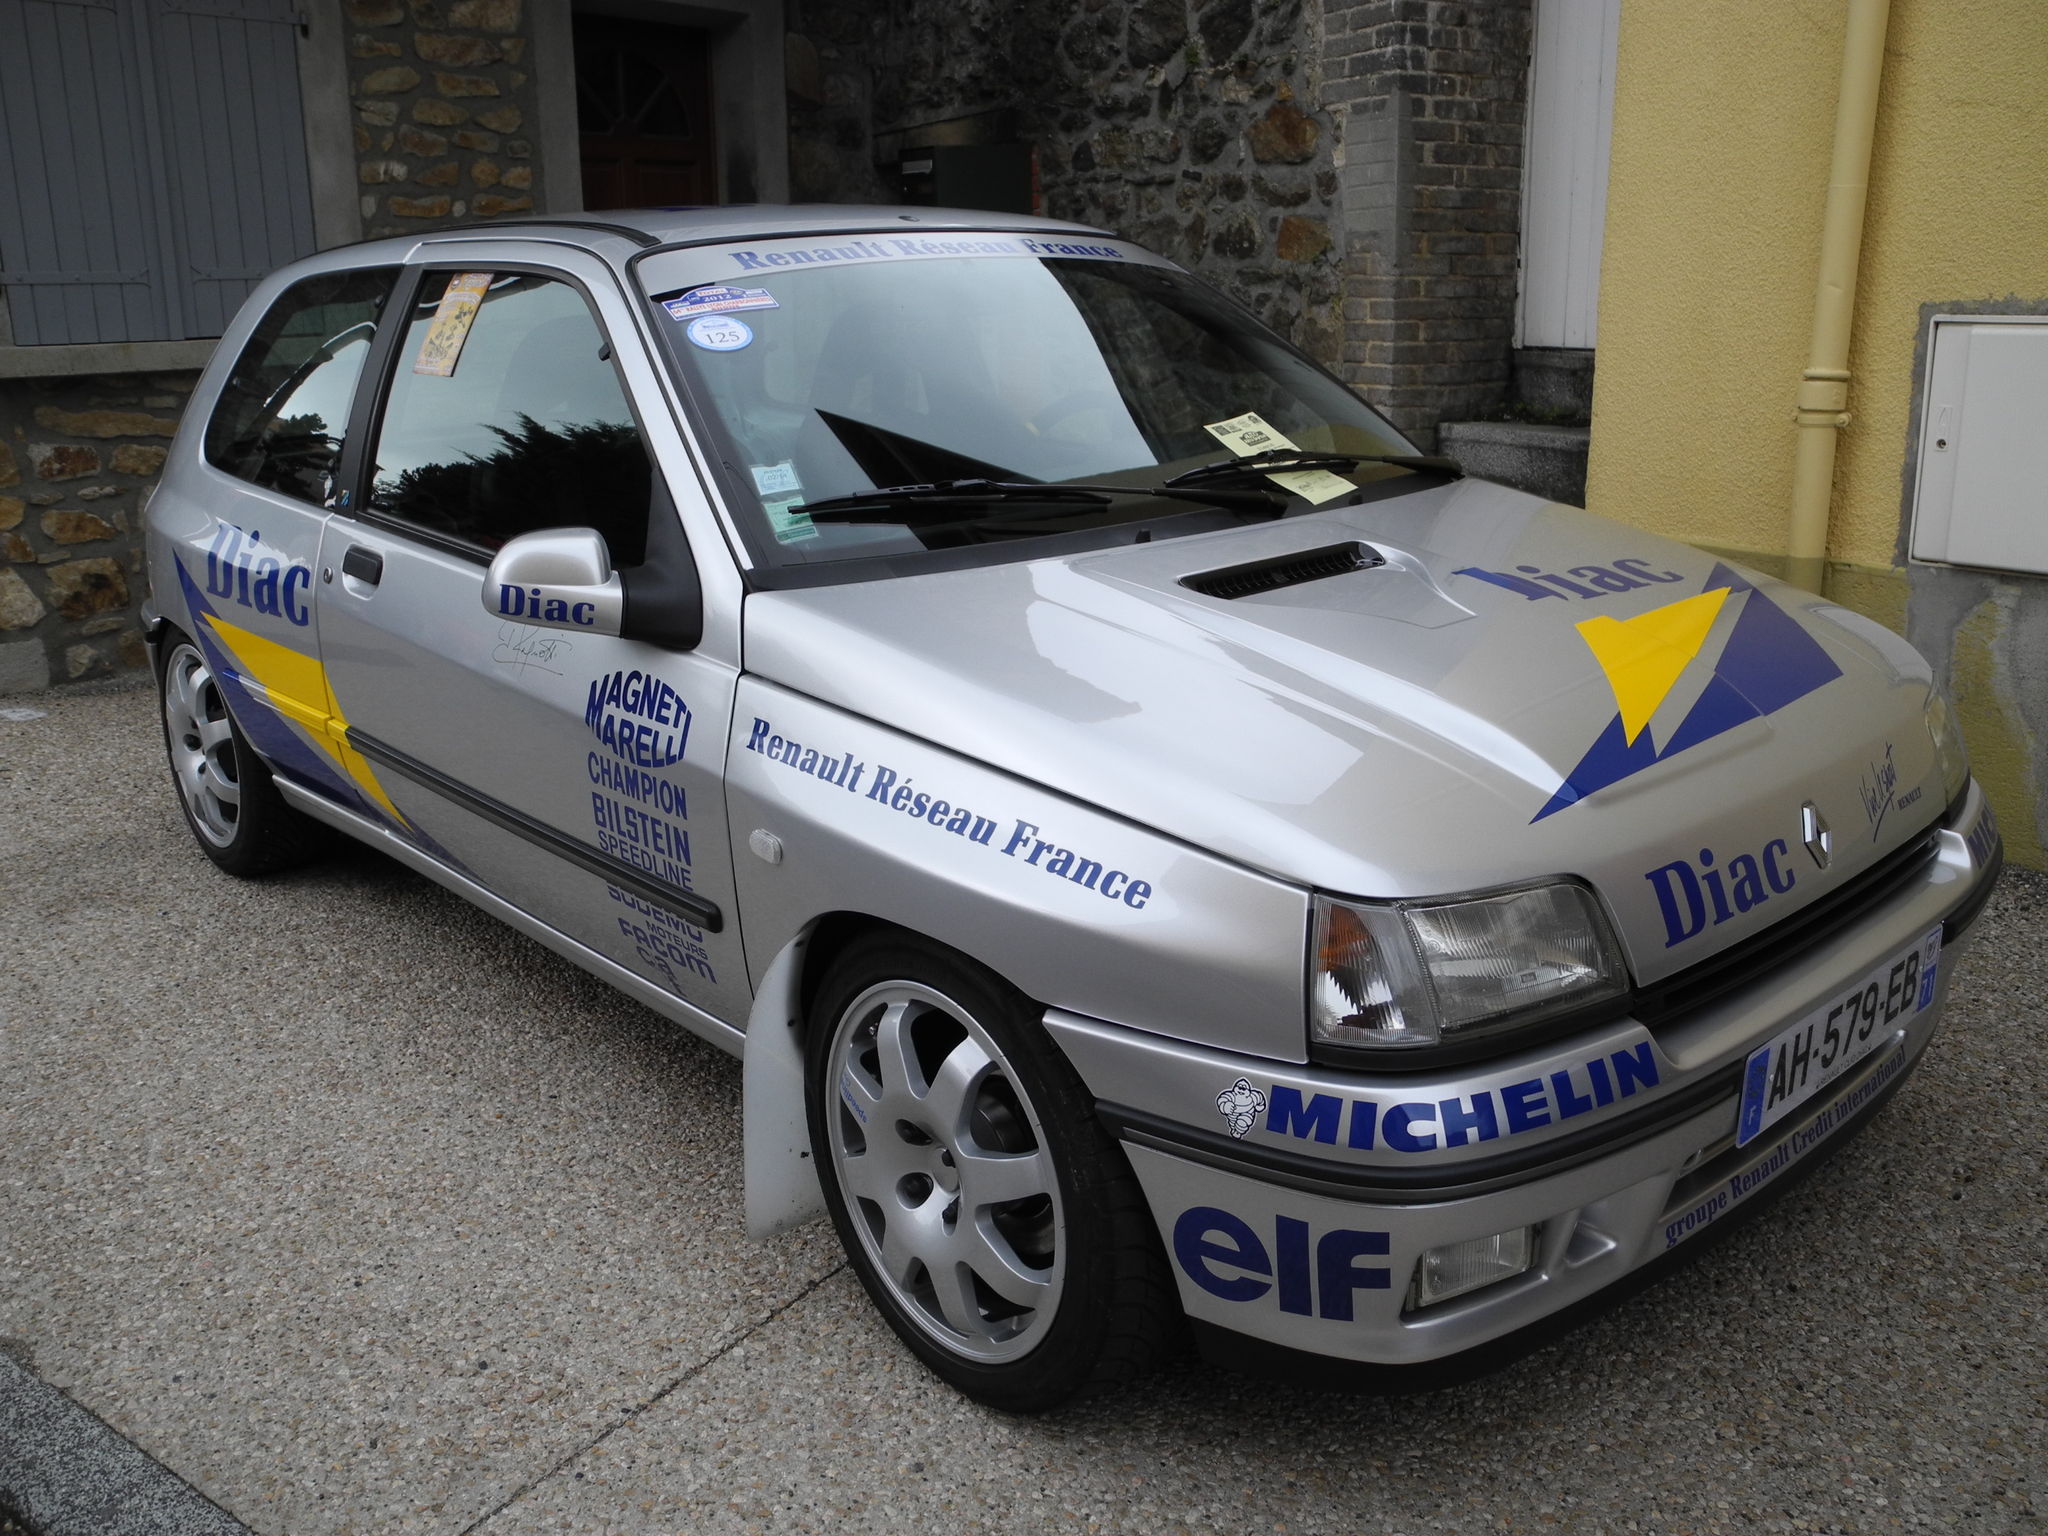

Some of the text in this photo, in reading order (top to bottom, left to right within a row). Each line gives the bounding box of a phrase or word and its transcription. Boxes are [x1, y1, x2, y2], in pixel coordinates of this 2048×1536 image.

[729, 238, 1124, 270] Renault Réseau France
[706, 330, 740, 344] 125
[206, 523, 311, 627] Diac
[498, 583, 595, 626] Diac
[1451, 558, 1685, 601] Diac
[587, 751, 688, 820] CHAMPION
[746, 717, 1153, 910] Renault Réseau France
[591, 791, 692, 866] BILSTEIN
[599, 830, 693, 891] SPEEDLINE
[1645, 838, 1796, 949] Diac
[646, 920, 709, 960] MOTEURS
[1266, 1041, 1660, 1153] MICHELIN
[1665, 1191, 1728, 1249] groupe
[1729, 1148, 1789, 1200] Renault
[1835, 1044, 1907, 1123] international
[1173, 1206, 1391, 1322] elf
